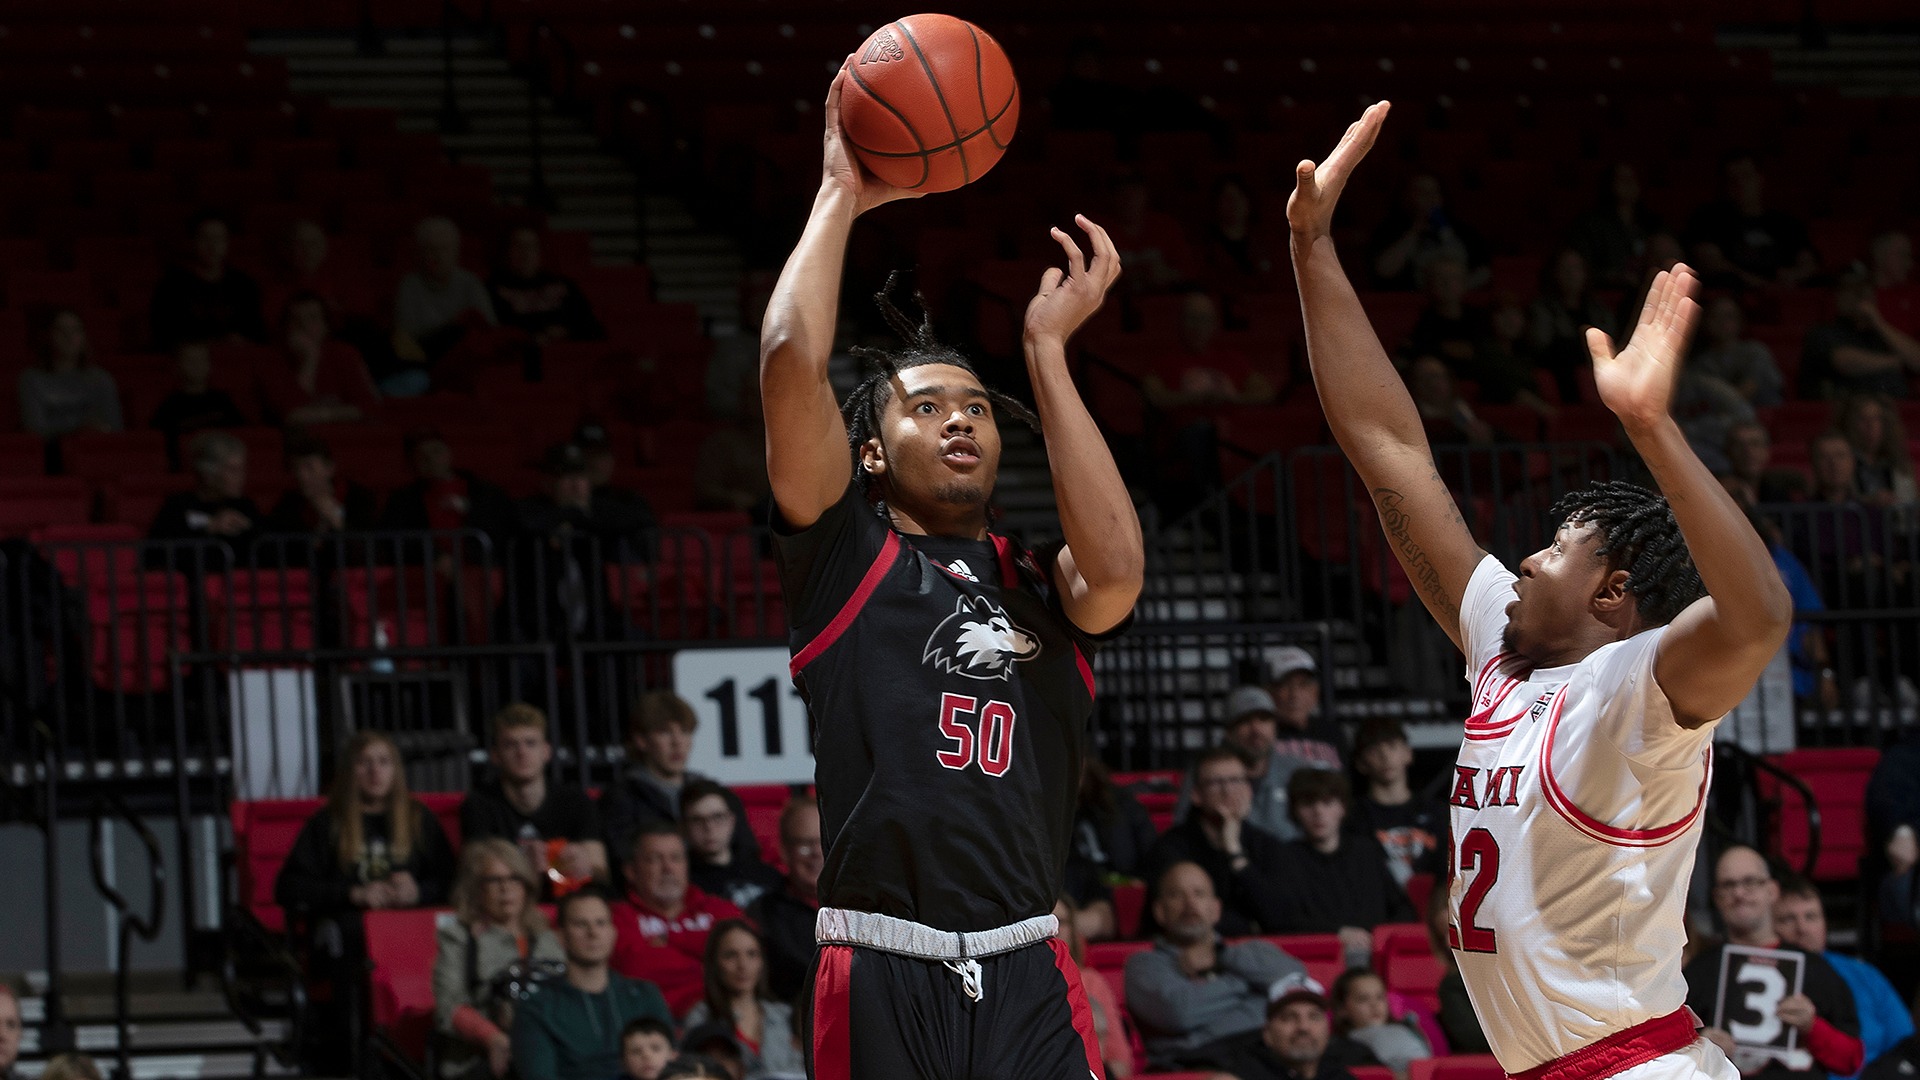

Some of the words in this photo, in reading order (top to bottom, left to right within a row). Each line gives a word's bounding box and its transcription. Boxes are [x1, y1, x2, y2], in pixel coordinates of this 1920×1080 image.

[935, 691, 1018, 778] 50
[1449, 764, 1526, 810] AMI
[1447, 826, 1500, 954] 2
[1728, 962, 1787, 1045] 3
